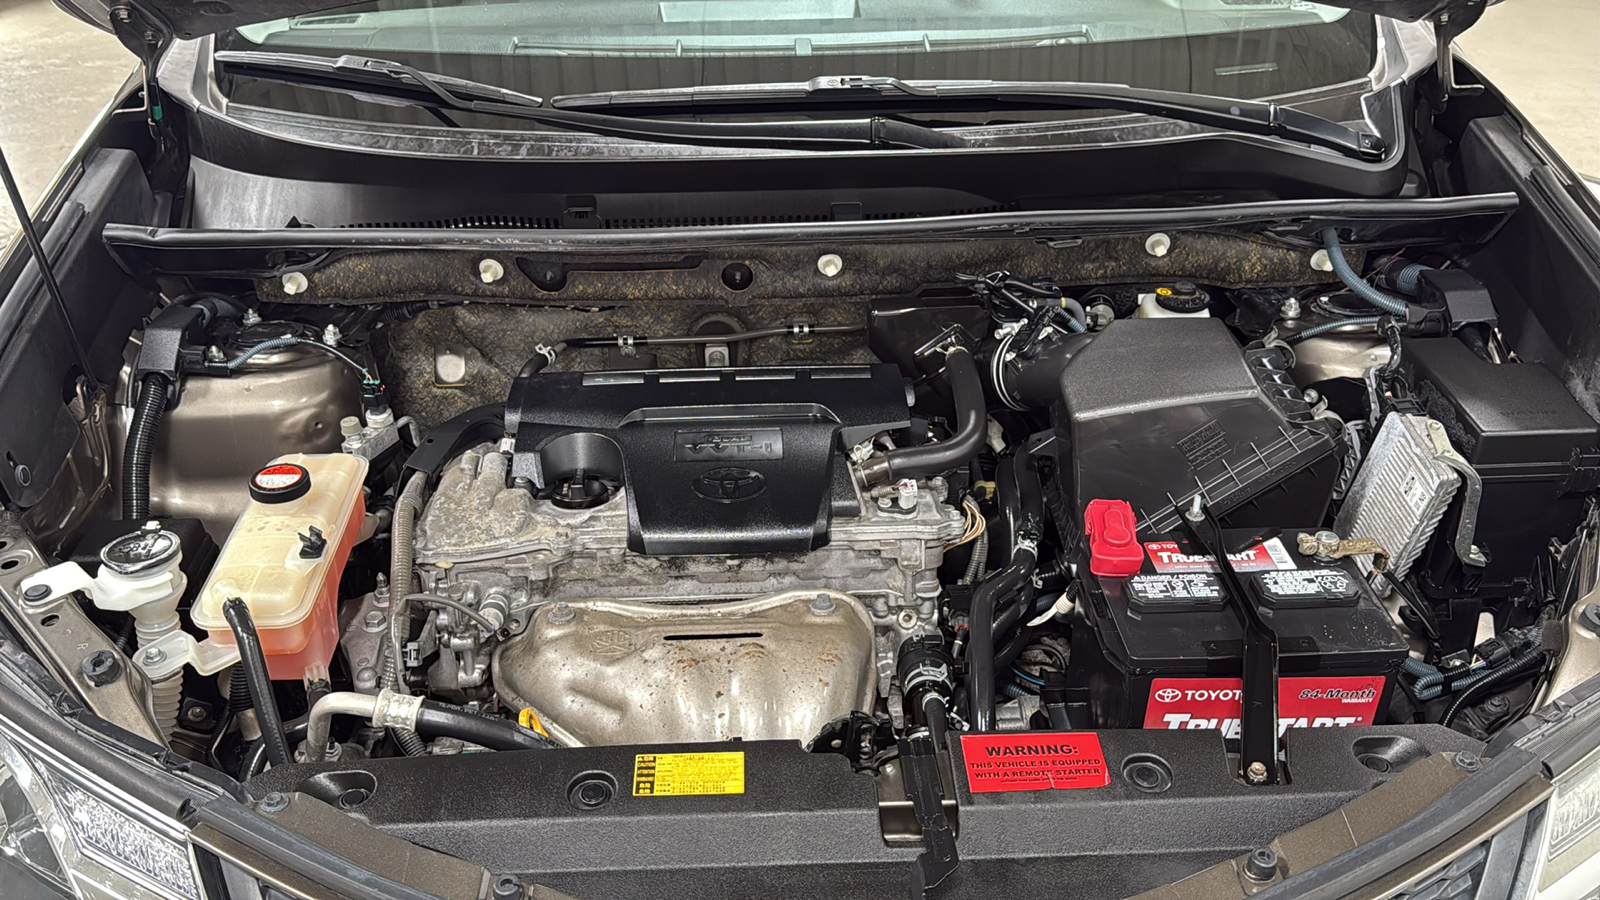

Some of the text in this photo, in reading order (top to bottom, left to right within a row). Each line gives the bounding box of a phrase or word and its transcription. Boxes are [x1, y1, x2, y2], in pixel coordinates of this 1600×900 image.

[1184, 689, 1242, 701] TOYOT
[1298, 687, 1377, 700] 84-Month
[985, 744, 1079, 757] WARNING:
[1052, 759, 1101, 767] EQUIPPED
[1012, 770, 1053, 778] REMOTE
